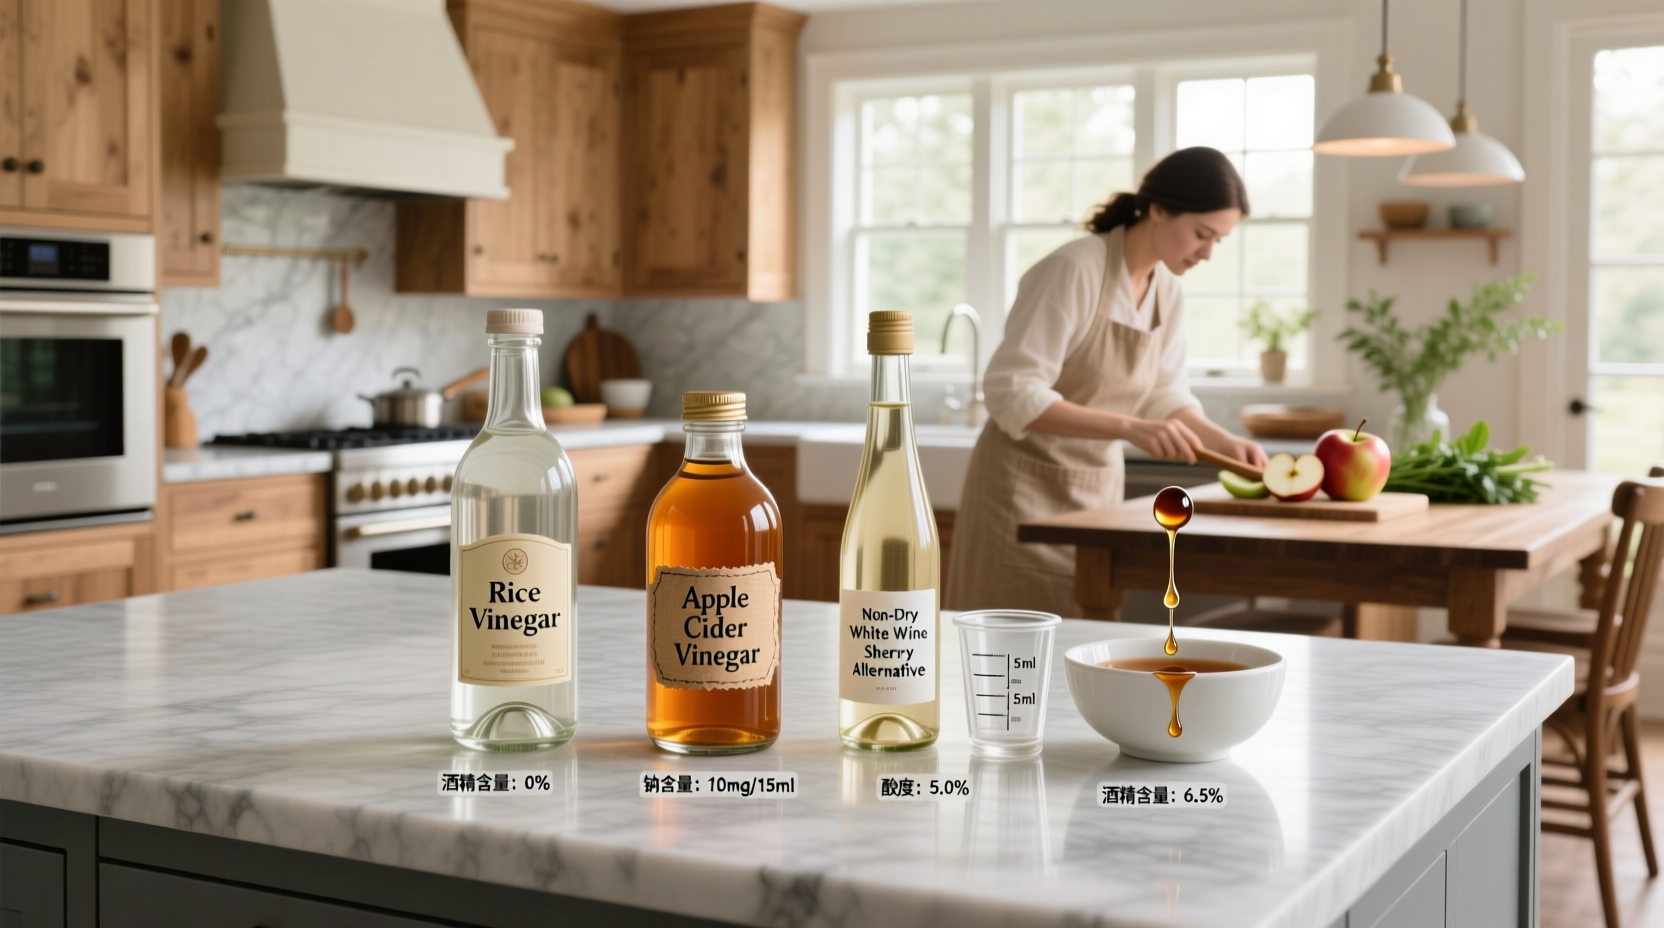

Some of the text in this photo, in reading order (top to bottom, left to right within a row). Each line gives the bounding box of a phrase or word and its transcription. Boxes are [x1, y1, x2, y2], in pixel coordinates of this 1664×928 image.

[488, 581, 541, 604] Rice
[681, 585, 749, 616] Apple
[469, 607, 561, 637] Vinegar
[862, 607, 919, 624] Non-Dry
[683, 615, 748, 639] Cider
[849, 624, 928, 640] White Wine
[673, 642, 761, 673] Vinegar
[864, 644, 914, 662] Sherry
[1013, 656, 1036, 669] 5ml
[1013, 692, 1036, 705] 5ml
